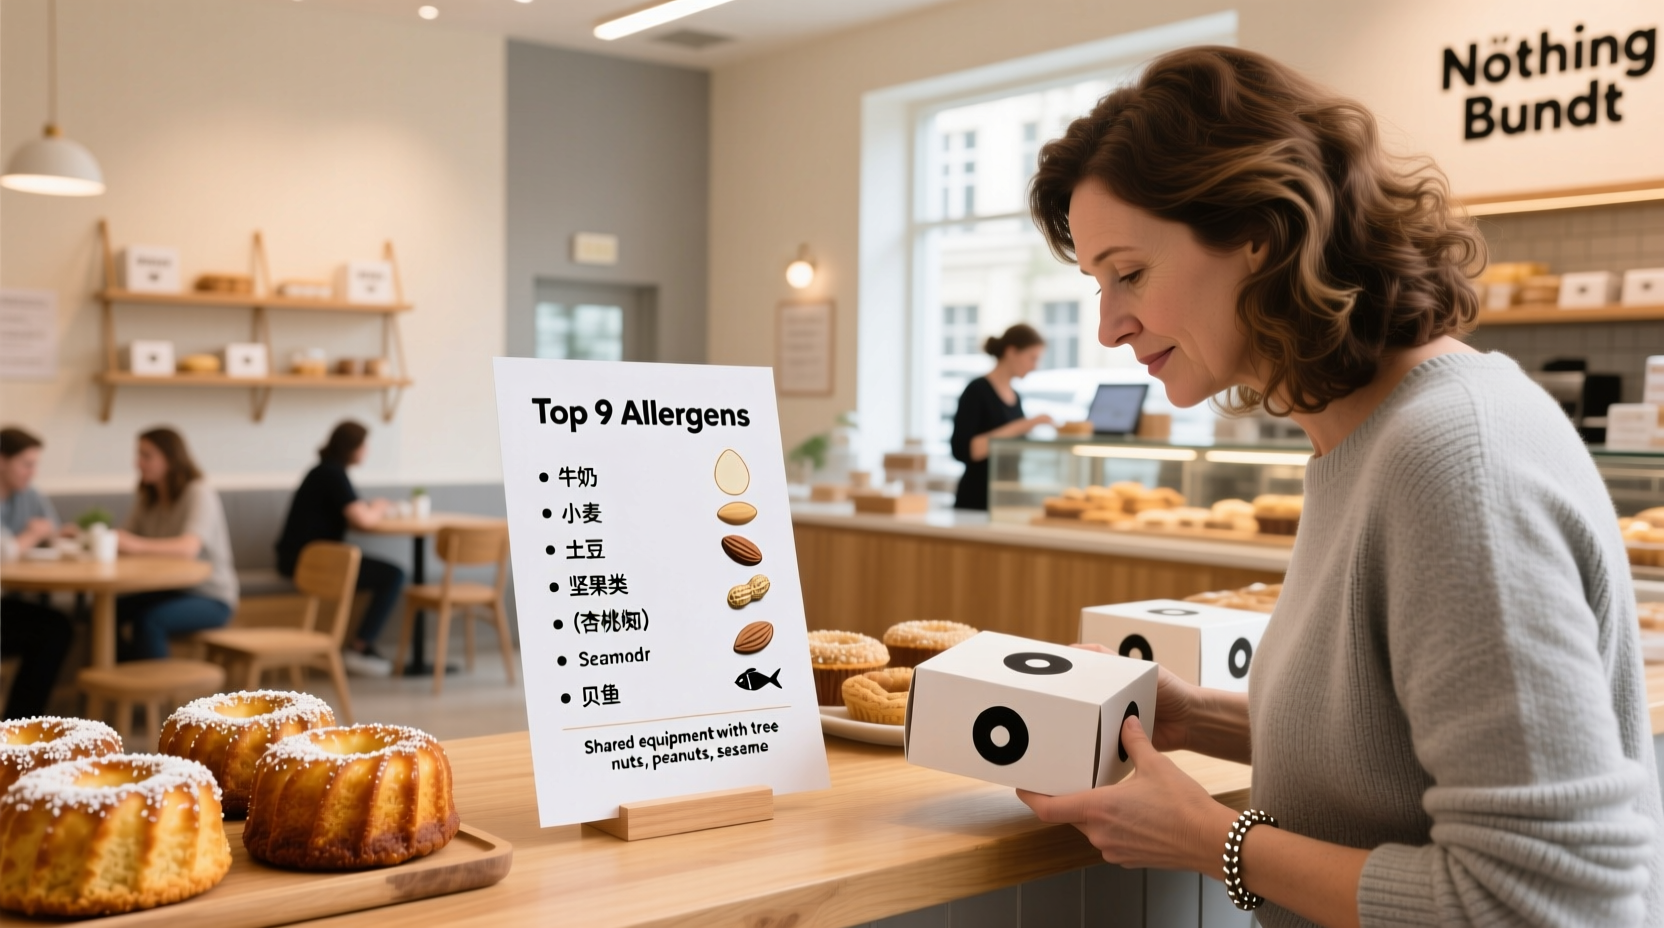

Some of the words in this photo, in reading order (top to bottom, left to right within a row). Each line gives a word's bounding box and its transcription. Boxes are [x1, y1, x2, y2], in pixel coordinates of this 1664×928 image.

[1442, 24, 1657, 91] Nöthing
[1463, 79, 1624, 141] Bundt
[531, 397, 588, 433] Top
[594, 398, 613, 426] 9
[620, 399, 751, 435] Allergens
[558, 465, 598, 488] 牛奶
[561, 501, 603, 524] 小麦
[565, 538, 606, 560] 土豆
[569, 573, 629, 597] 坚果类
[584, 734, 635, 755] Shared
[638, 726, 715, 752] equipment
[716, 721, 748, 739] with
[750, 720, 779, 735] tree
[611, 755, 649, 771] nuts,
[652, 747, 714, 771] peanuts,
[717, 742, 769, 758] sesame
